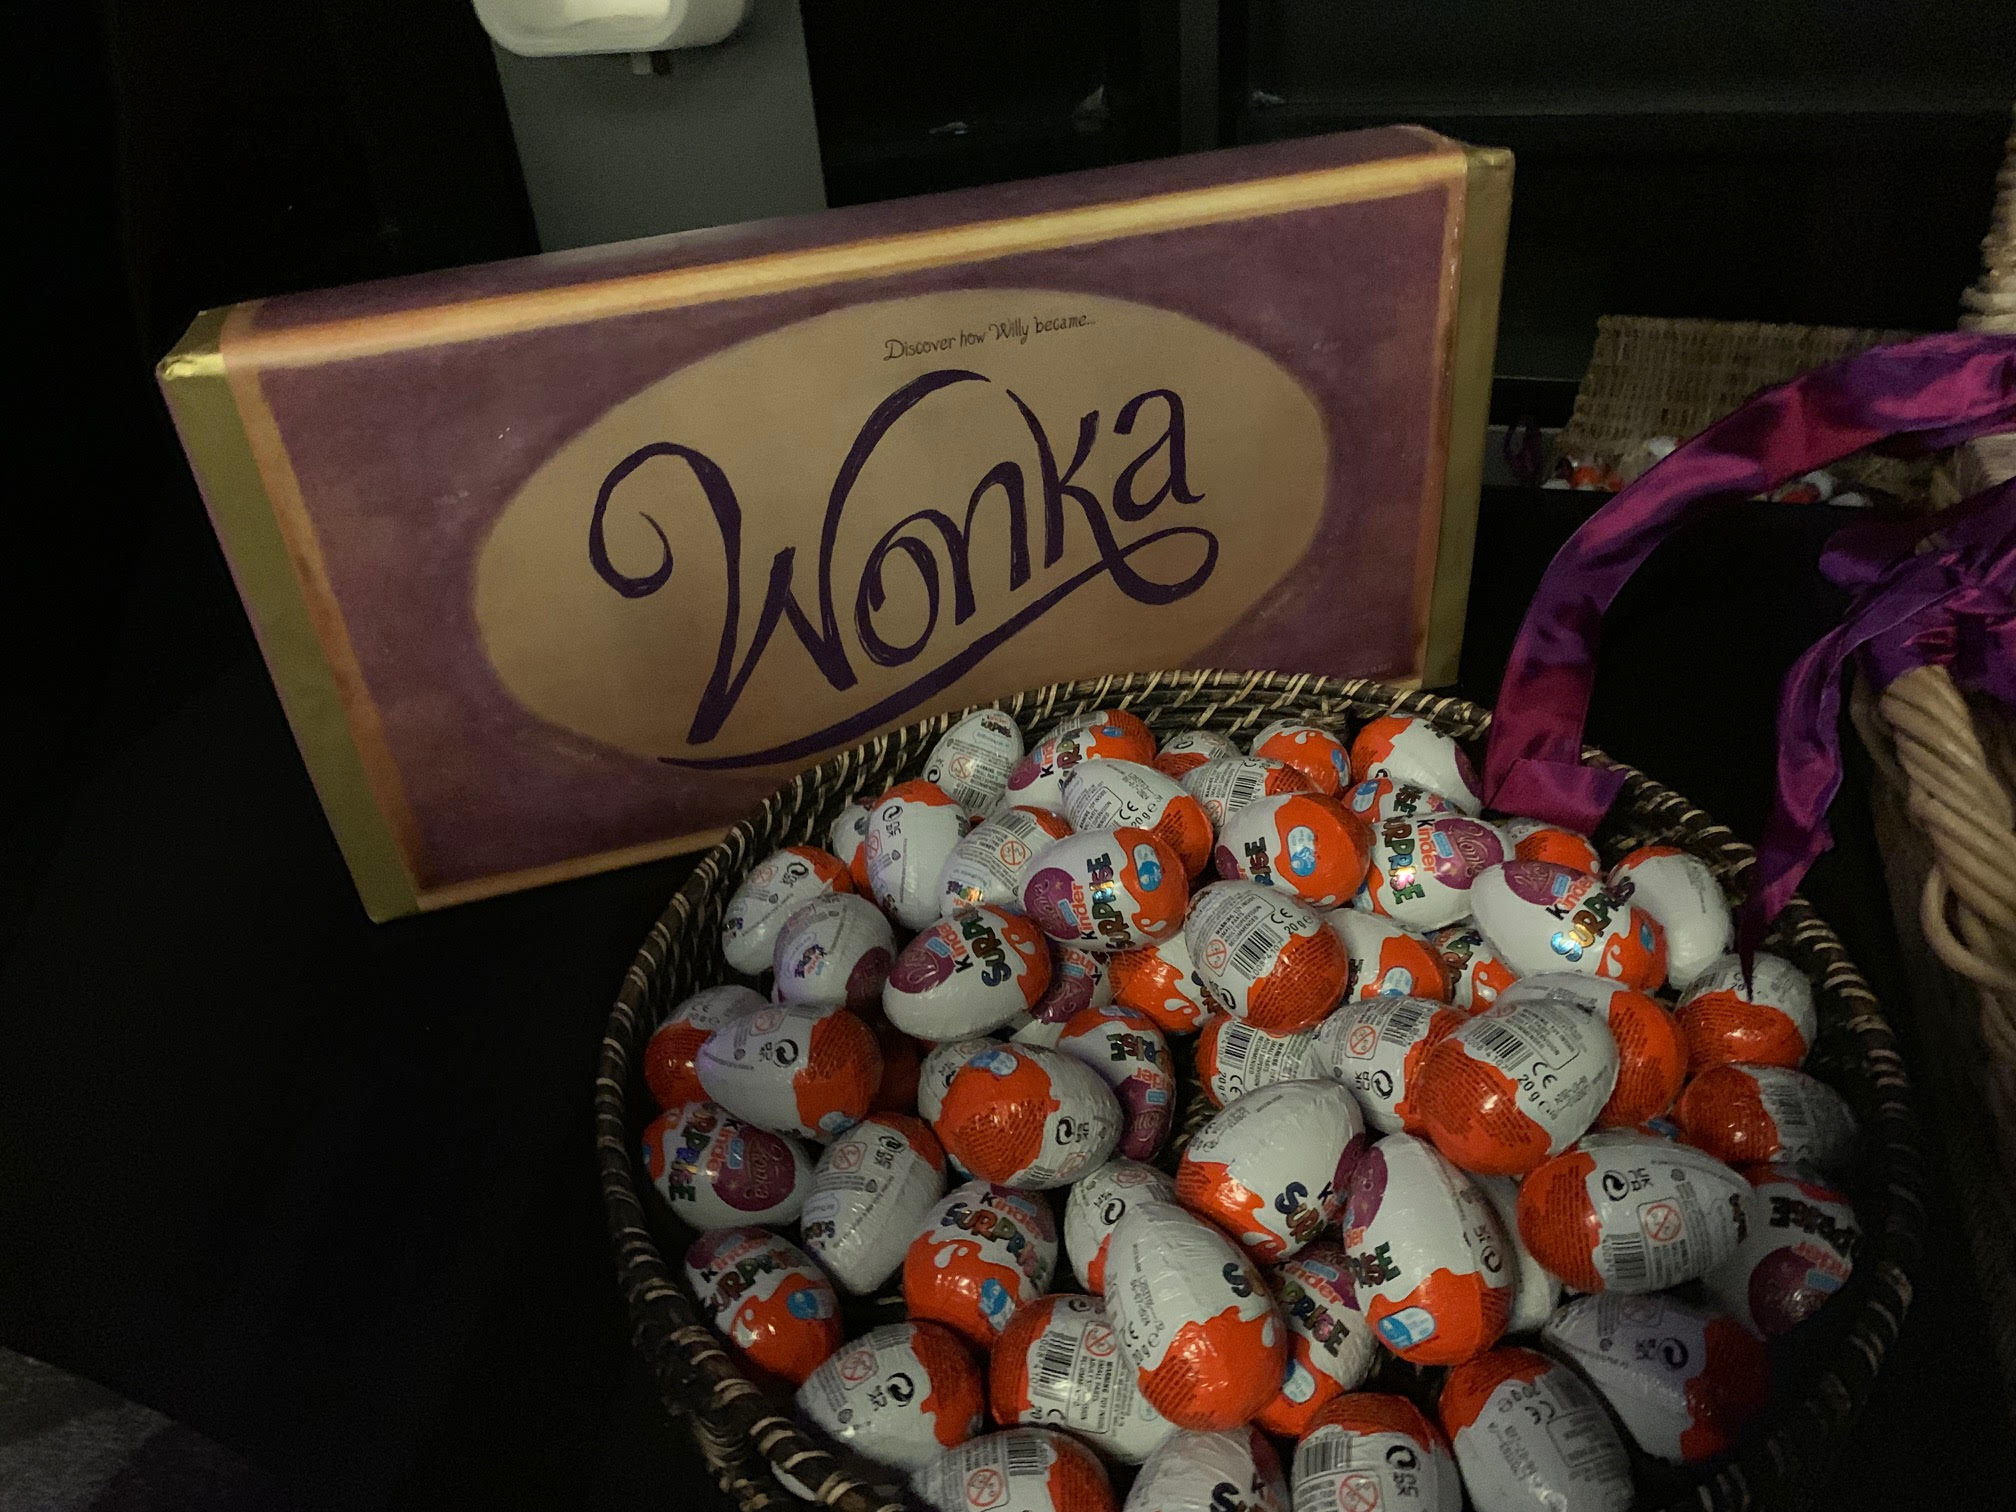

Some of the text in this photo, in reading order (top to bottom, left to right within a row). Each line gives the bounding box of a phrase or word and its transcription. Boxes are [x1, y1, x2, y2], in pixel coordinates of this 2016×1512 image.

[883, 338, 956, 361] Discover
[960, 330, 986, 347] how
[988, 318, 1029, 344] Willy
[589, 369, 1219, 770] Wonka
